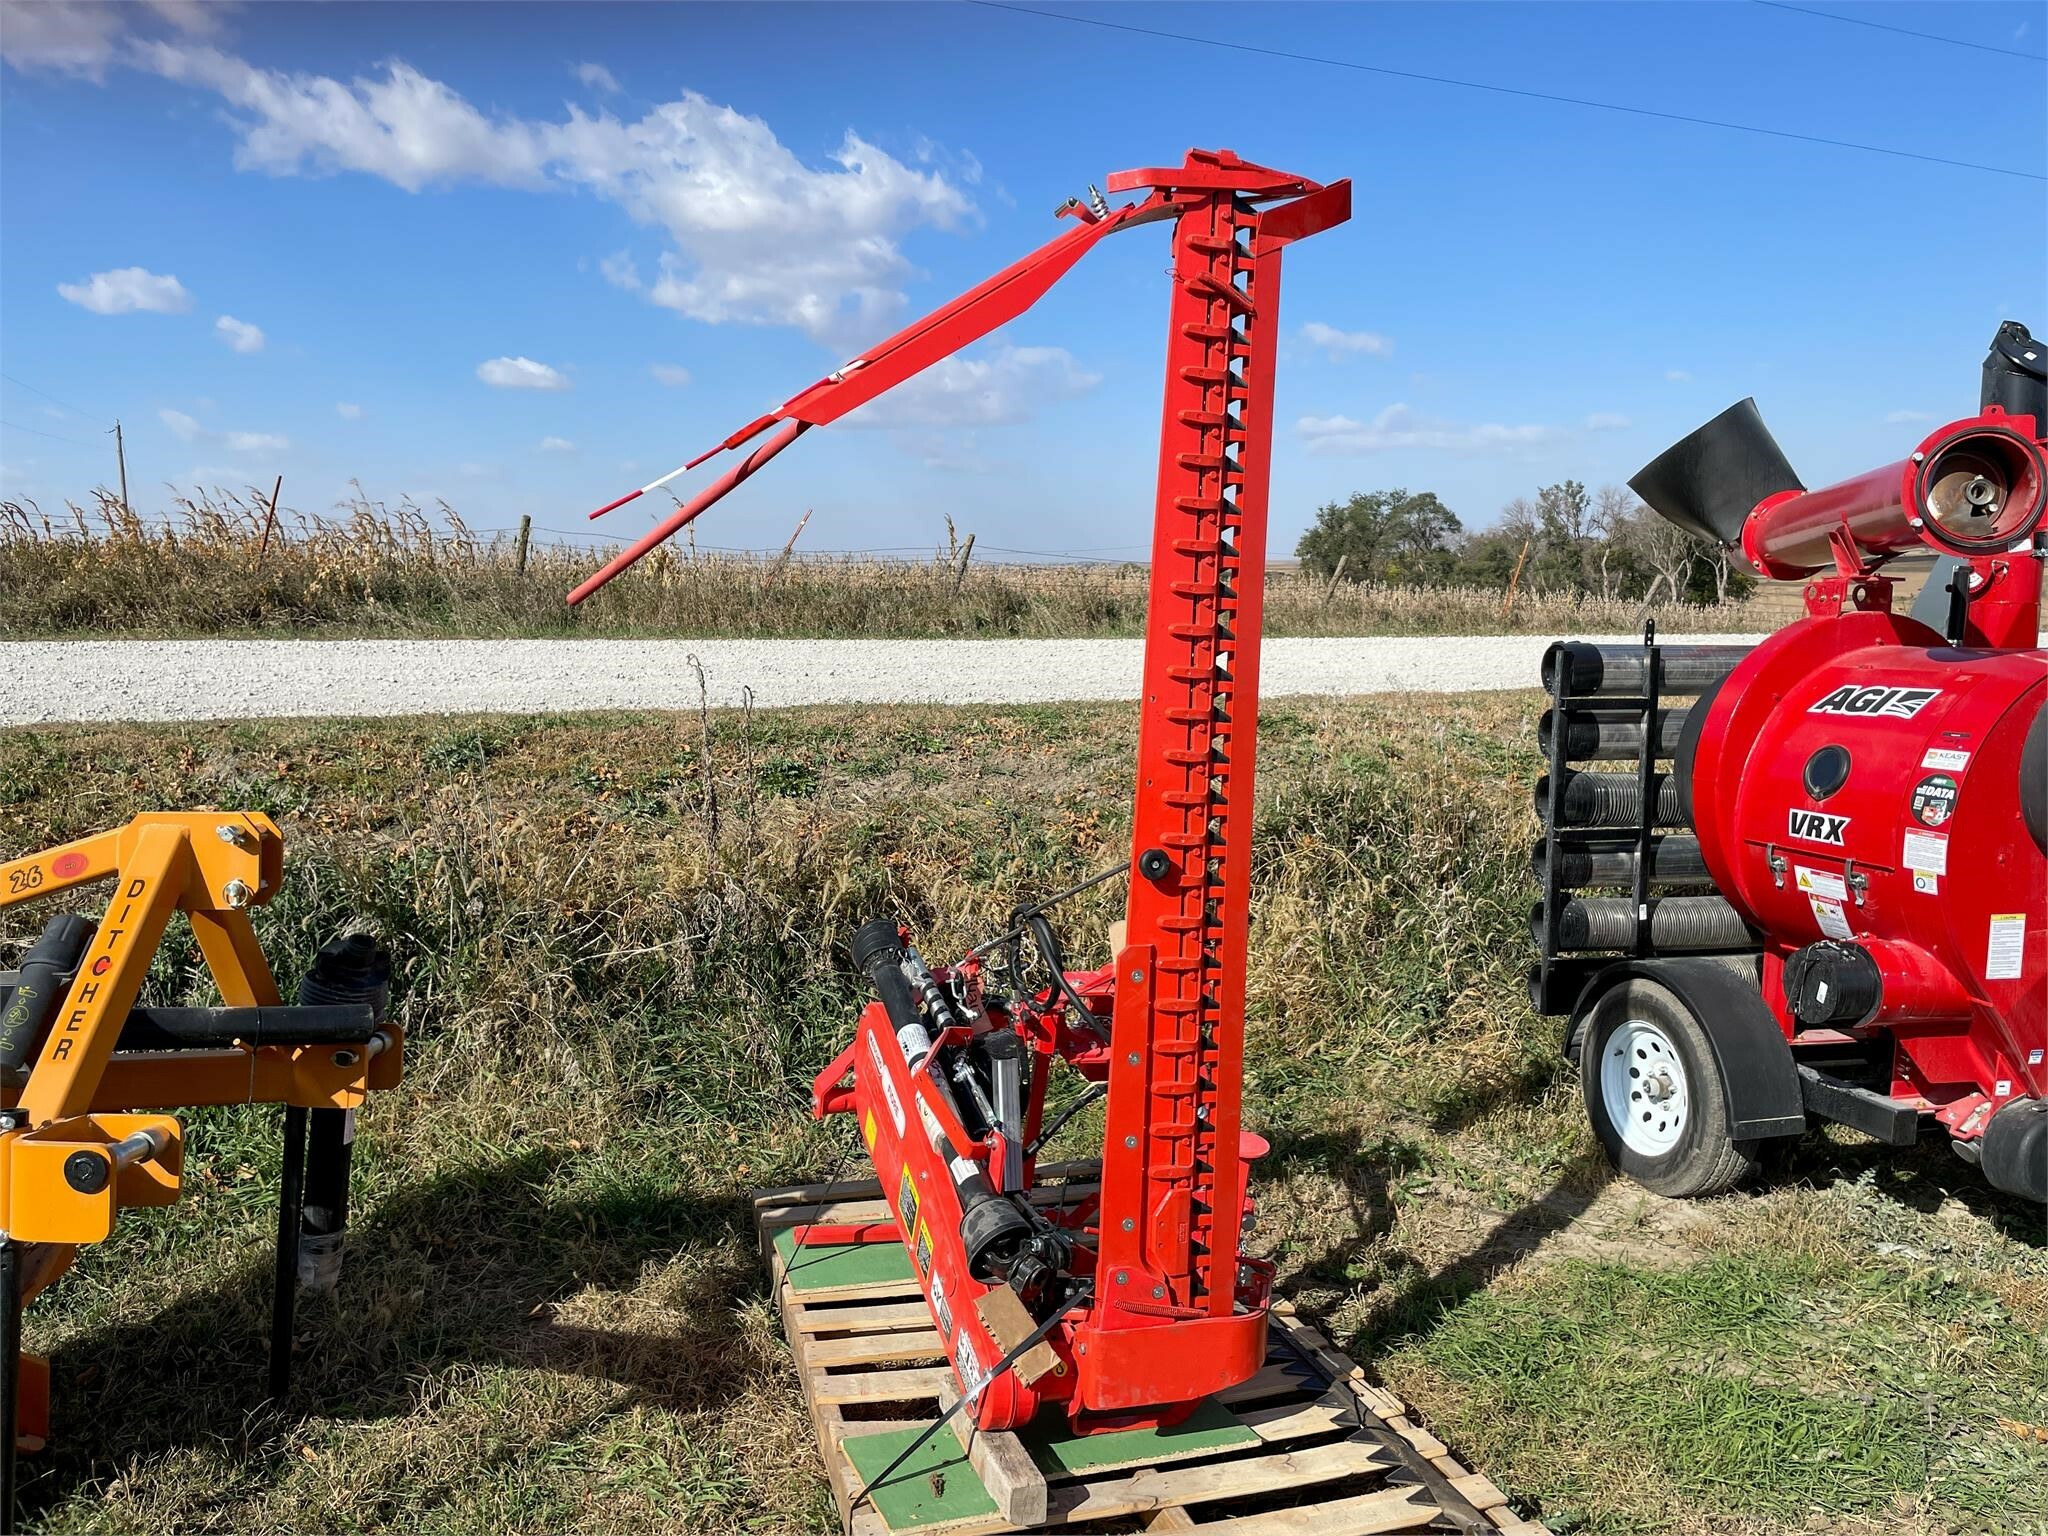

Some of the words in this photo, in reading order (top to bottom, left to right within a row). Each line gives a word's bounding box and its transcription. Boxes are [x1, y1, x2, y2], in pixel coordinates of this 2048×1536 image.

[1813, 687, 1901, 713] AGI
[1926, 785, 1955, 800] DATA
[1791, 812, 1846, 843] VRX
[9, 865, 43, 893] 26
[52, 879, 145, 1060] DITCHER
